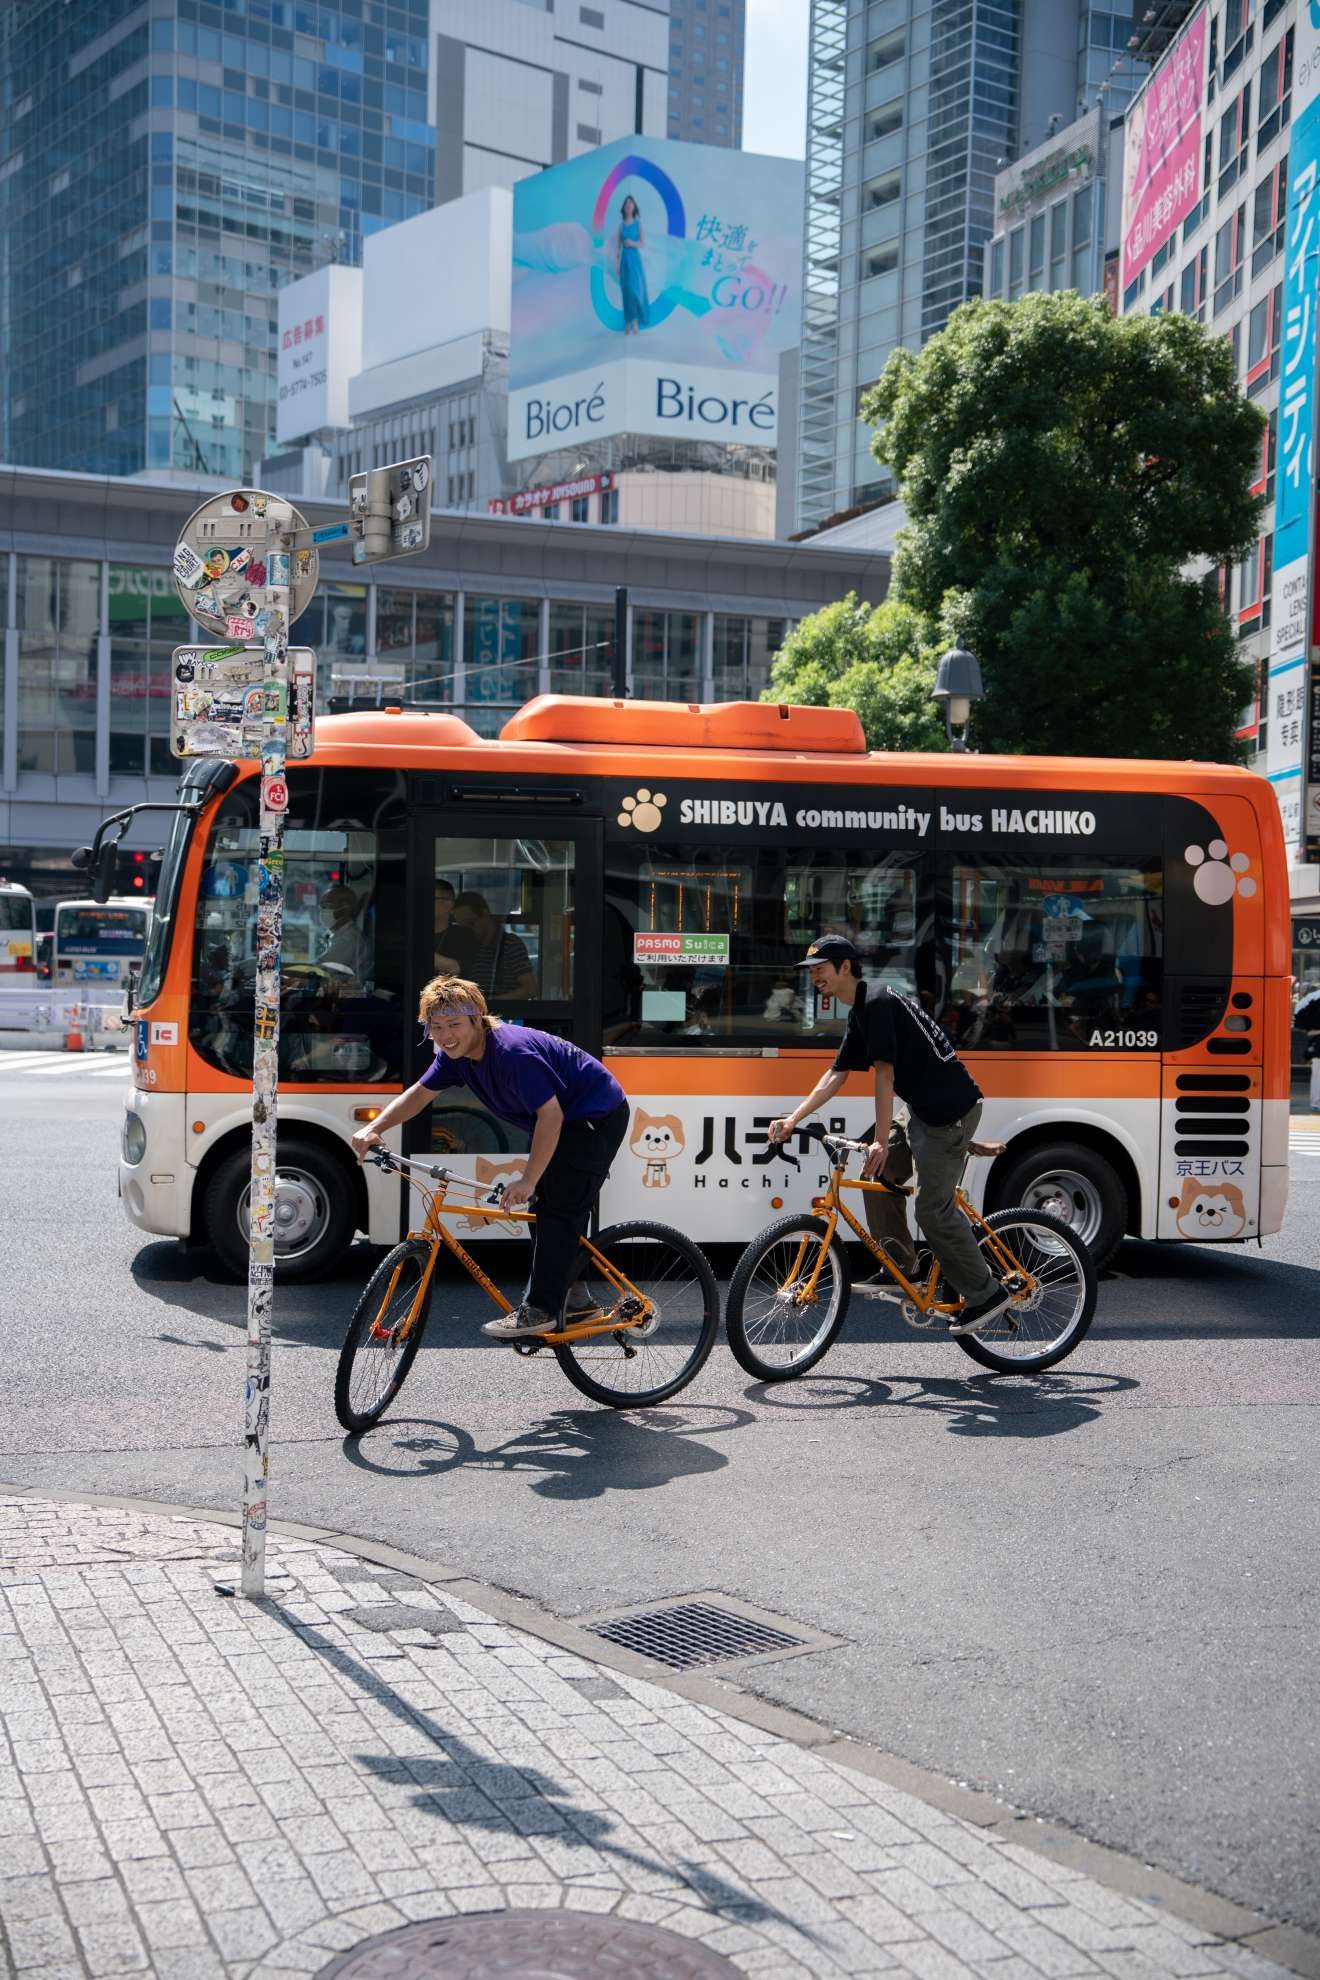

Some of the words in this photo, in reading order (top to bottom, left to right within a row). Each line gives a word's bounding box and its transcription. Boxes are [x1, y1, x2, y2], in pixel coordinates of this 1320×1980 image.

[712, 275, 788, 315] Go!!
[527, 382, 605, 440] Bioré
[656, 378, 775, 430] Bioré
[680, 799, 788, 827] SHIBUYA
[796, 804, 931, 837] community
[940, 806, 983, 833] bus
[991, 808, 1096, 836] HACHIKO
[637, 938, 681, 949] PASMO
[684, 939, 725, 950] Suica
[636, 953, 726, 963] ご利用いただけます
[1089, 1030, 1158, 1047] A21039
[1176, 1159, 1245, 1177] 京王バス
[694, 1174, 789, 1188] Hachi
